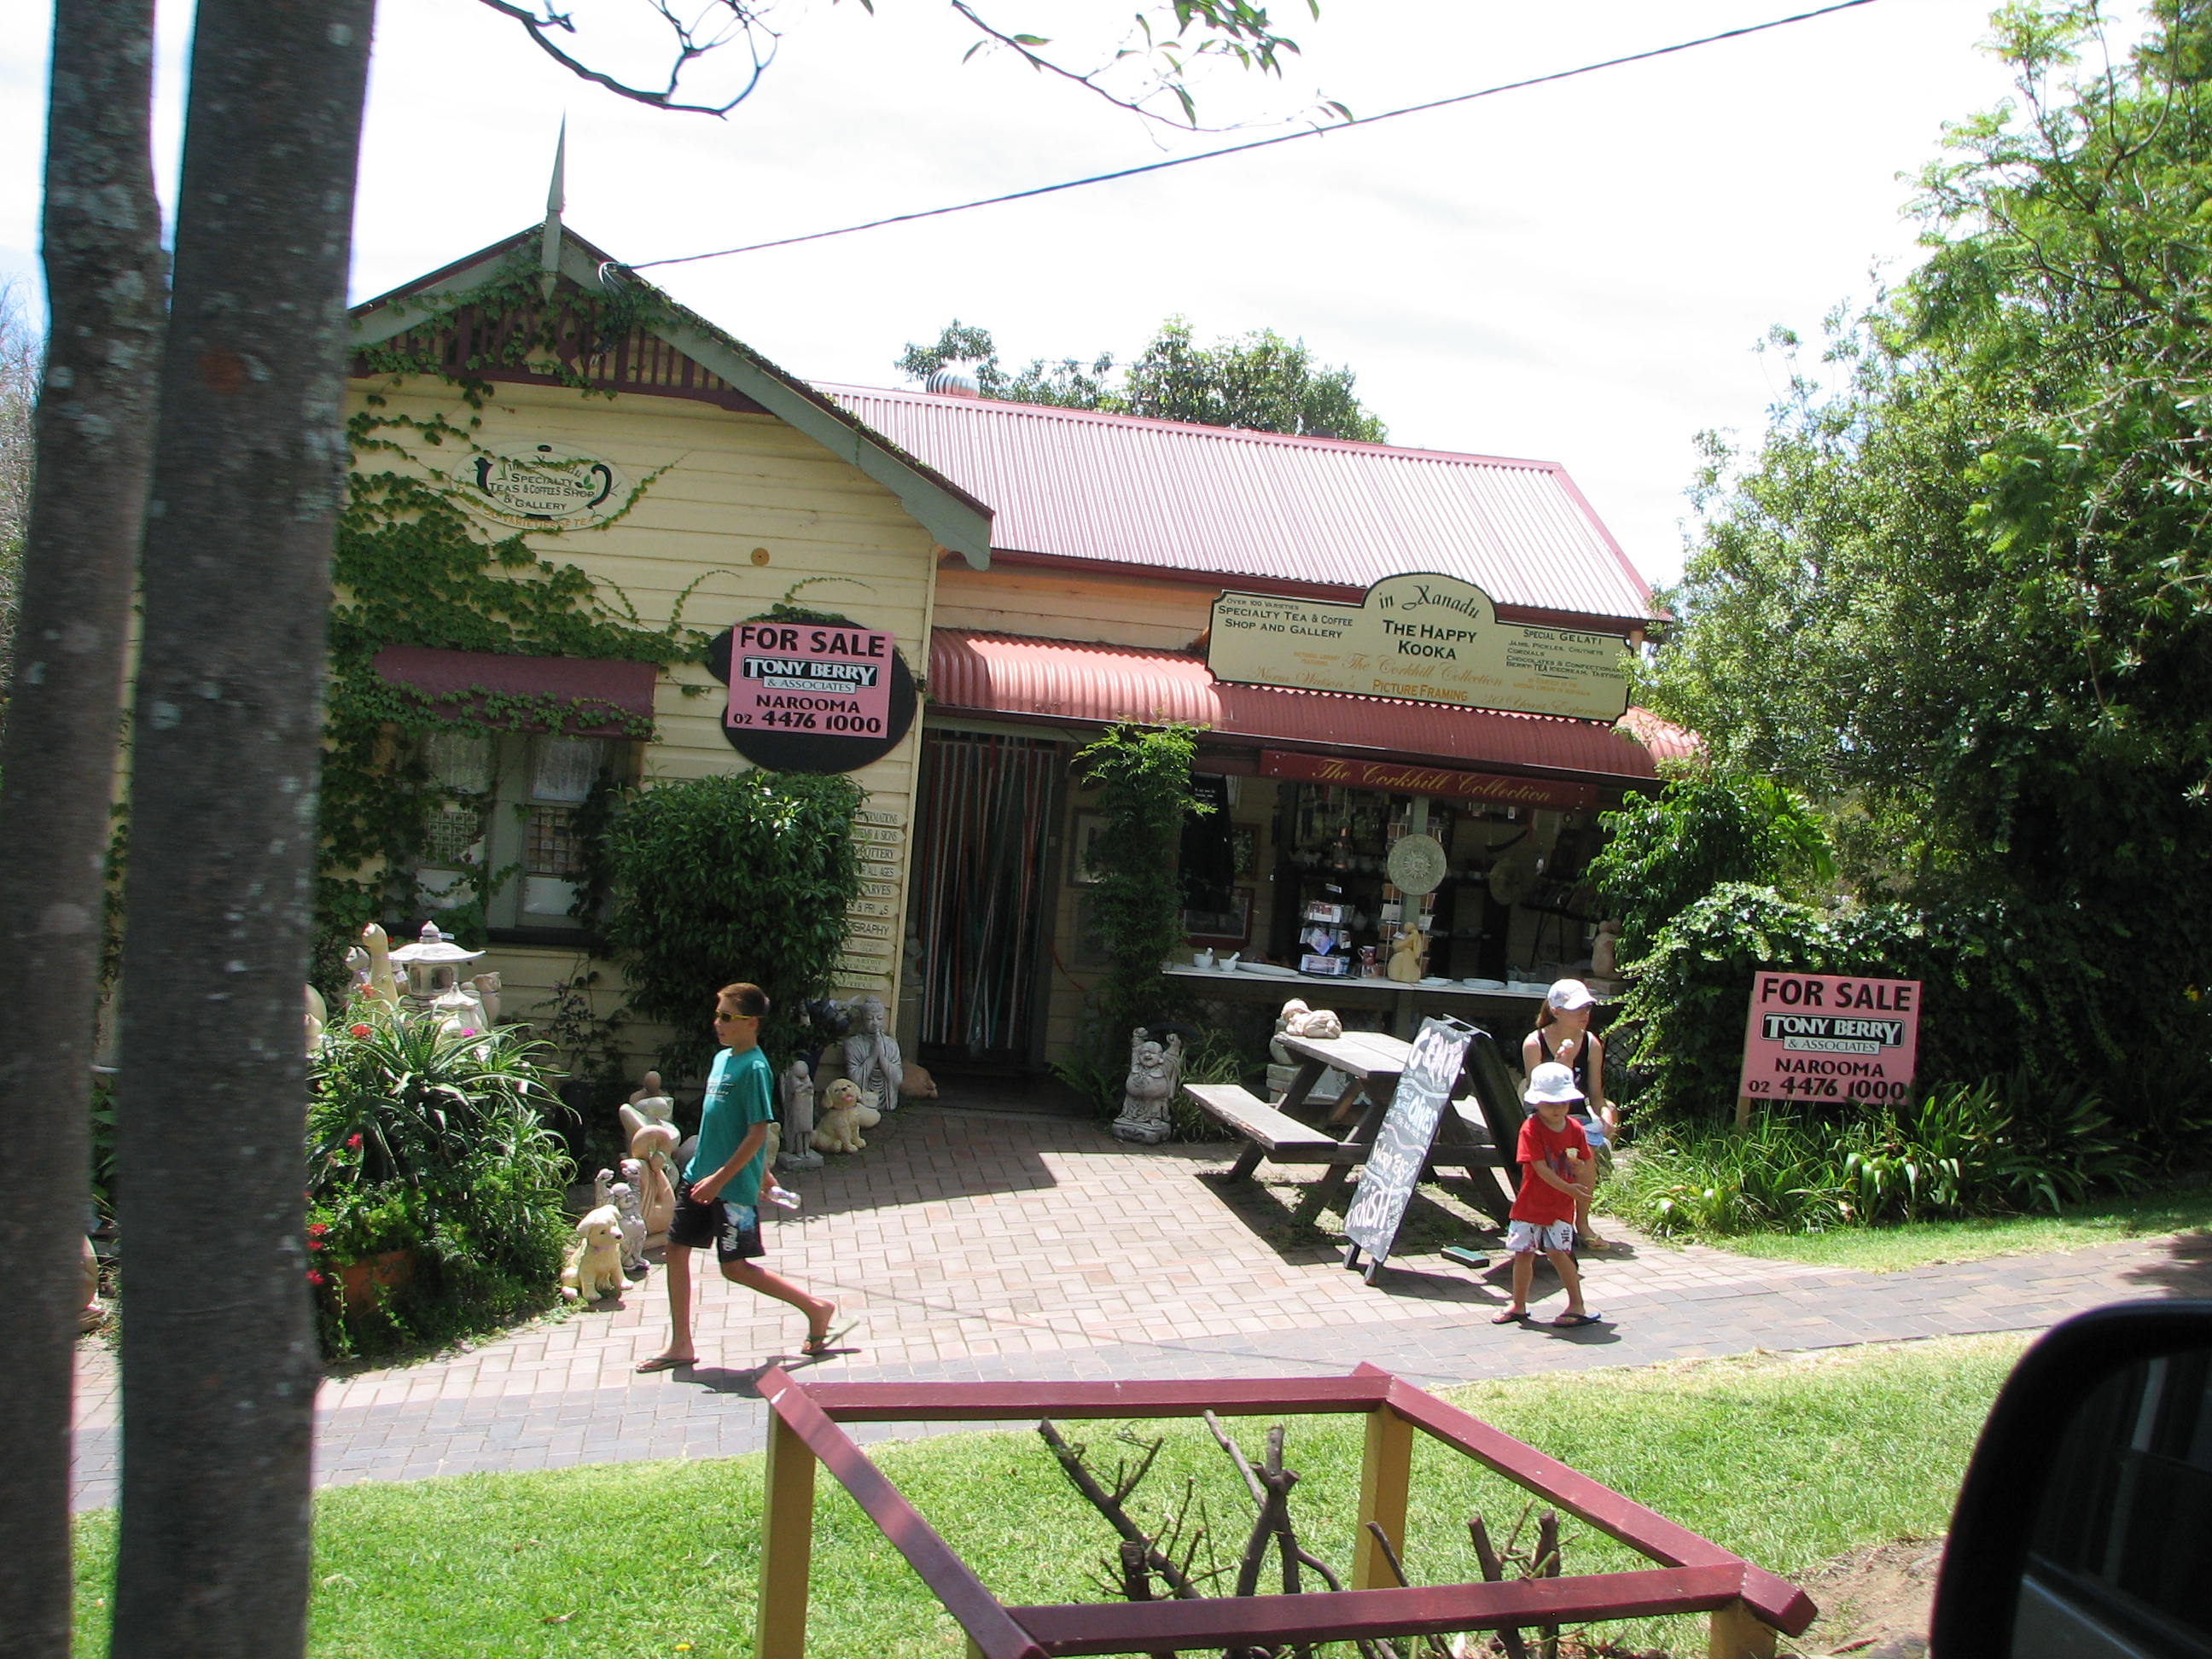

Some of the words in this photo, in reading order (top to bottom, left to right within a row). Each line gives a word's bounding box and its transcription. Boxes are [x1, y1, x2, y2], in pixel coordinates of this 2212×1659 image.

[489, 482, 520, 493] TEAS
[523, 484, 527, 493] &
[529, 485, 561, 496] COFFEES
[562, 488, 595, 498] SHOP
[511, 473, 573, 486] SPECIALTY
[504, 494, 510, 504] &
[515, 498, 567, 510] GALLERY
[574, 517, 595, 527] TEA
[1264, 601, 1299, 610] VARIETIES
[1378, 591, 1394, 609] in
[1401, 585, 1480, 619] Xanadu
[1218, 605, 1280, 620] SPECIALTY
[1284, 611, 1307, 622] TEA
[1311, 614, 1318, 623] &
[1321, 615, 1353, 626] COFFEE
[1225, 619, 1256, 630] SHOP
[1260, 623, 1285, 633] AND
[1290, 625, 1343, 639] GALLERY
[1382, 620, 1417, 637] THE
[1420, 624, 1477, 643] HAPPY
[1523, 629, 1555, 640] SPECIAL
[1559, 632, 1602, 645] GELATI
[740, 626, 798, 651] FOR
[811, 632, 886, 658] SALE
[1398, 640, 1457, 661] KOOKA
[1507, 648, 1545, 656] CORDIALS
[745, 659, 808, 678] TONY
[811, 664, 876, 685] BERRY
[1342, 653, 1370, 670] The
[1439, 662, 1503, 686] Collection
[767, 679, 777, 688] &
[782, 679, 852, 692] ASSOCIATES
[1372, 679, 1419, 695] PICTURE
[1420, 684, 1468, 701] FRAMING
[756, 695, 860, 713] NAROOMA
[734, 713, 753, 725] 02
[761, 711, 817, 729] 4476
[826, 715, 881, 733] 1000
[1312, 759, 1351, 780] The
[1362, 765, 1450, 792] Corkhill
[1458, 773, 1551, 802] Collection
[1761, 978, 1824, 1006] FOR
[1835, 982, 1912, 1011] SALE
[1766, 1016, 1831, 1038] TONY
[1835, 1020, 1901, 1045] BERRY
[1788, 1039, 1797, 1048] &
[1802, 1039, 1876, 1052] ASSOCIATES
[1774, 1057, 1884, 1078] NAROOMA
[1749, 1080, 1769, 1092] 02
[1780, 1077, 1837, 1096] 4476
[1847, 1080, 1905, 1099] 1000
